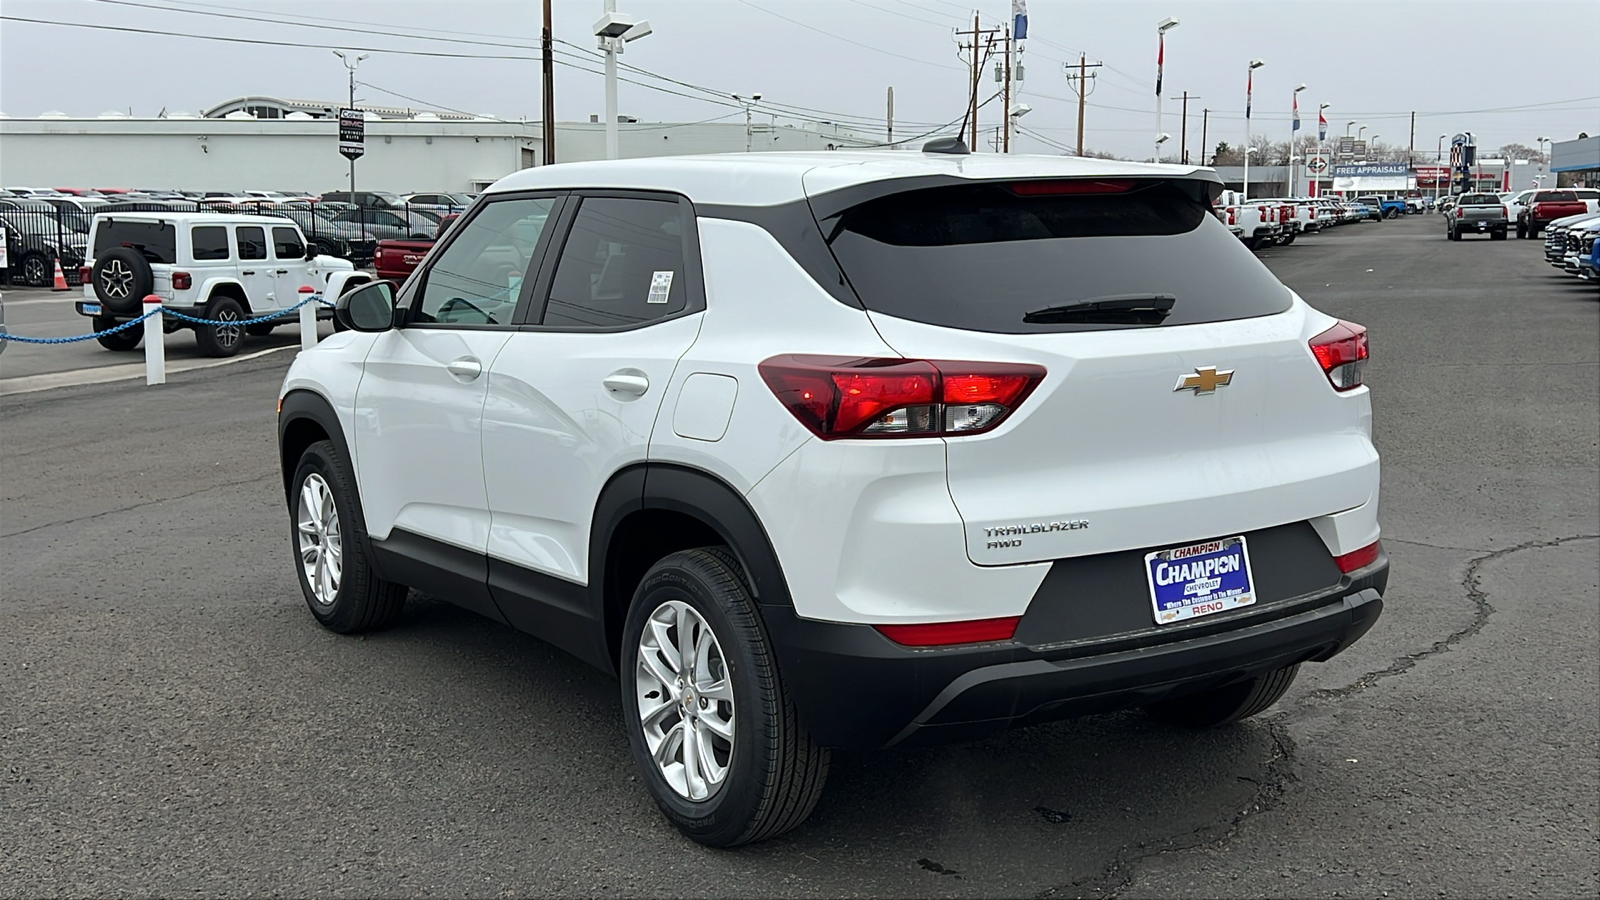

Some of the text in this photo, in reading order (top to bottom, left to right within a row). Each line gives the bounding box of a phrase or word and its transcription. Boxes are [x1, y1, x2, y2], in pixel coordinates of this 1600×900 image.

[341, 120, 363, 128] GMC
[1357, 166, 1405, 174] APPRAISALS!
[983, 519, 1090, 537] TRAILBLAZER
[987, 538, 1022, 549] AWD
[1174, 542, 1220, 558] CHAMPION
[1156, 553, 1240, 586] CHAMPION
[1185, 579, 1219, 592] CHEVROLET
[1182, 598, 1191, 606] The
[1192, 594, 1213, 604] Customer
[1192, 601, 1223, 615] RENO
